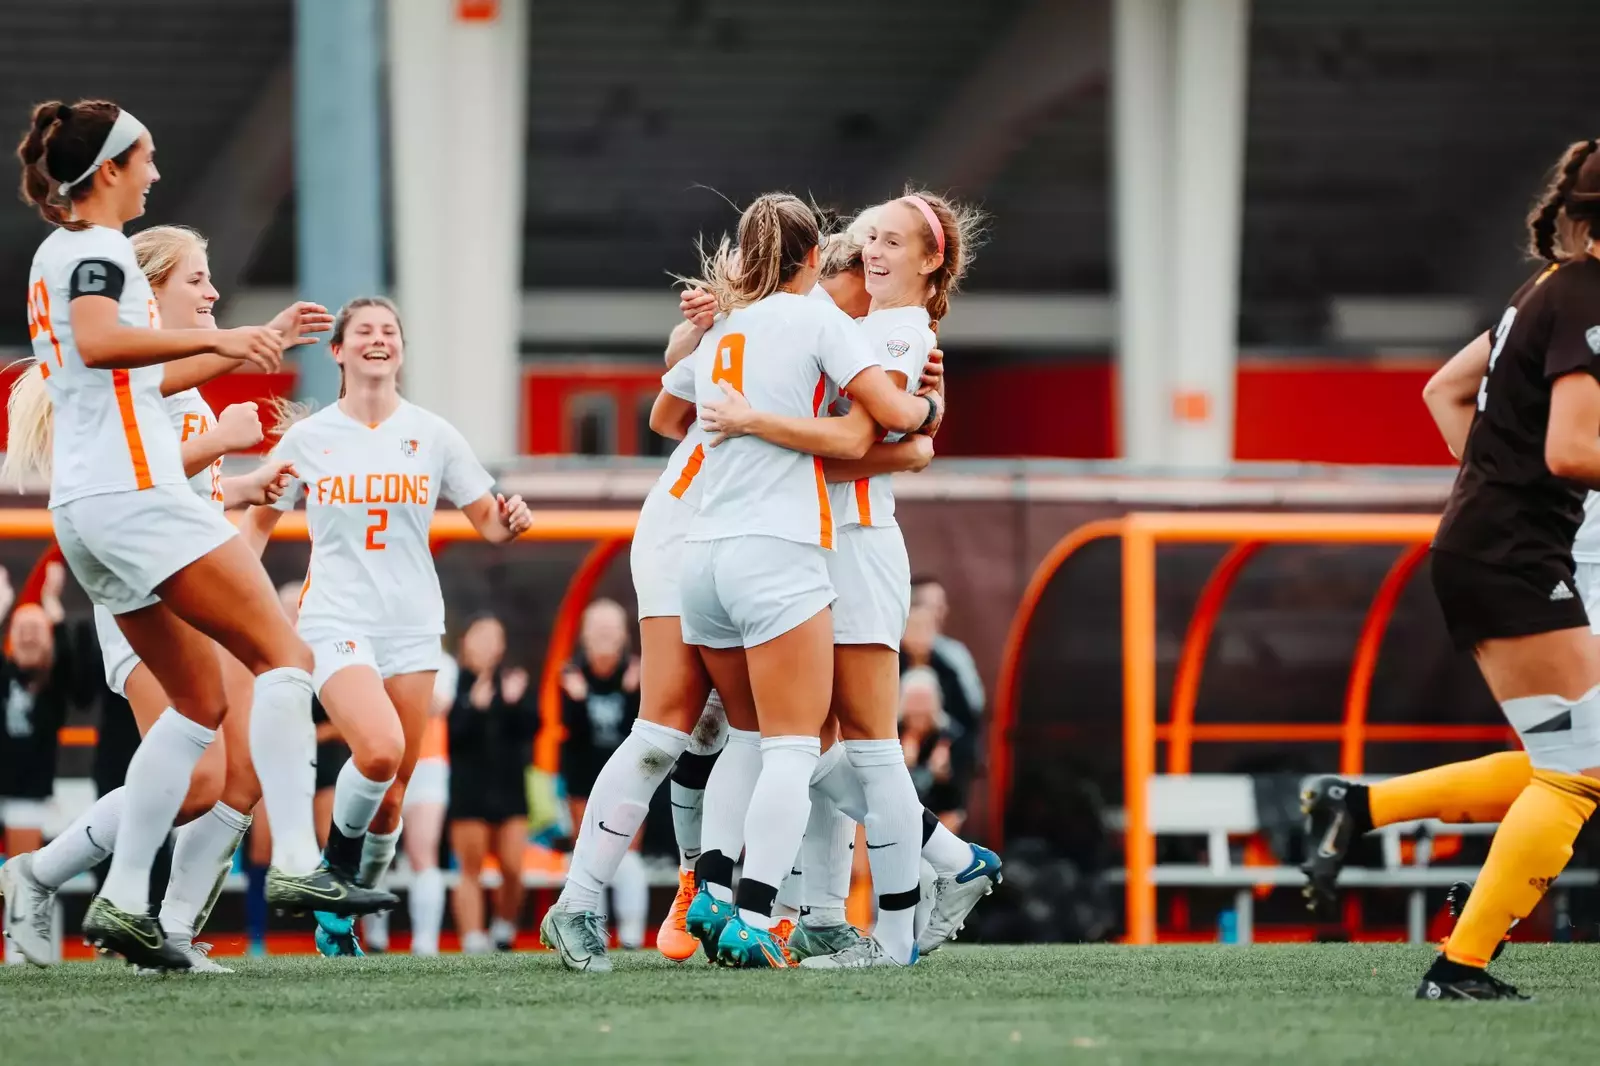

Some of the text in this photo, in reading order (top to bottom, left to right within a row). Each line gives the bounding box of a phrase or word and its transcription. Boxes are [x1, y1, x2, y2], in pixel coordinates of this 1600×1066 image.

[78, 263, 107, 292] C
[711, 332, 746, 397] 9
[316, 474, 430, 504] FALCONS
[365, 508, 388, 550] 2
